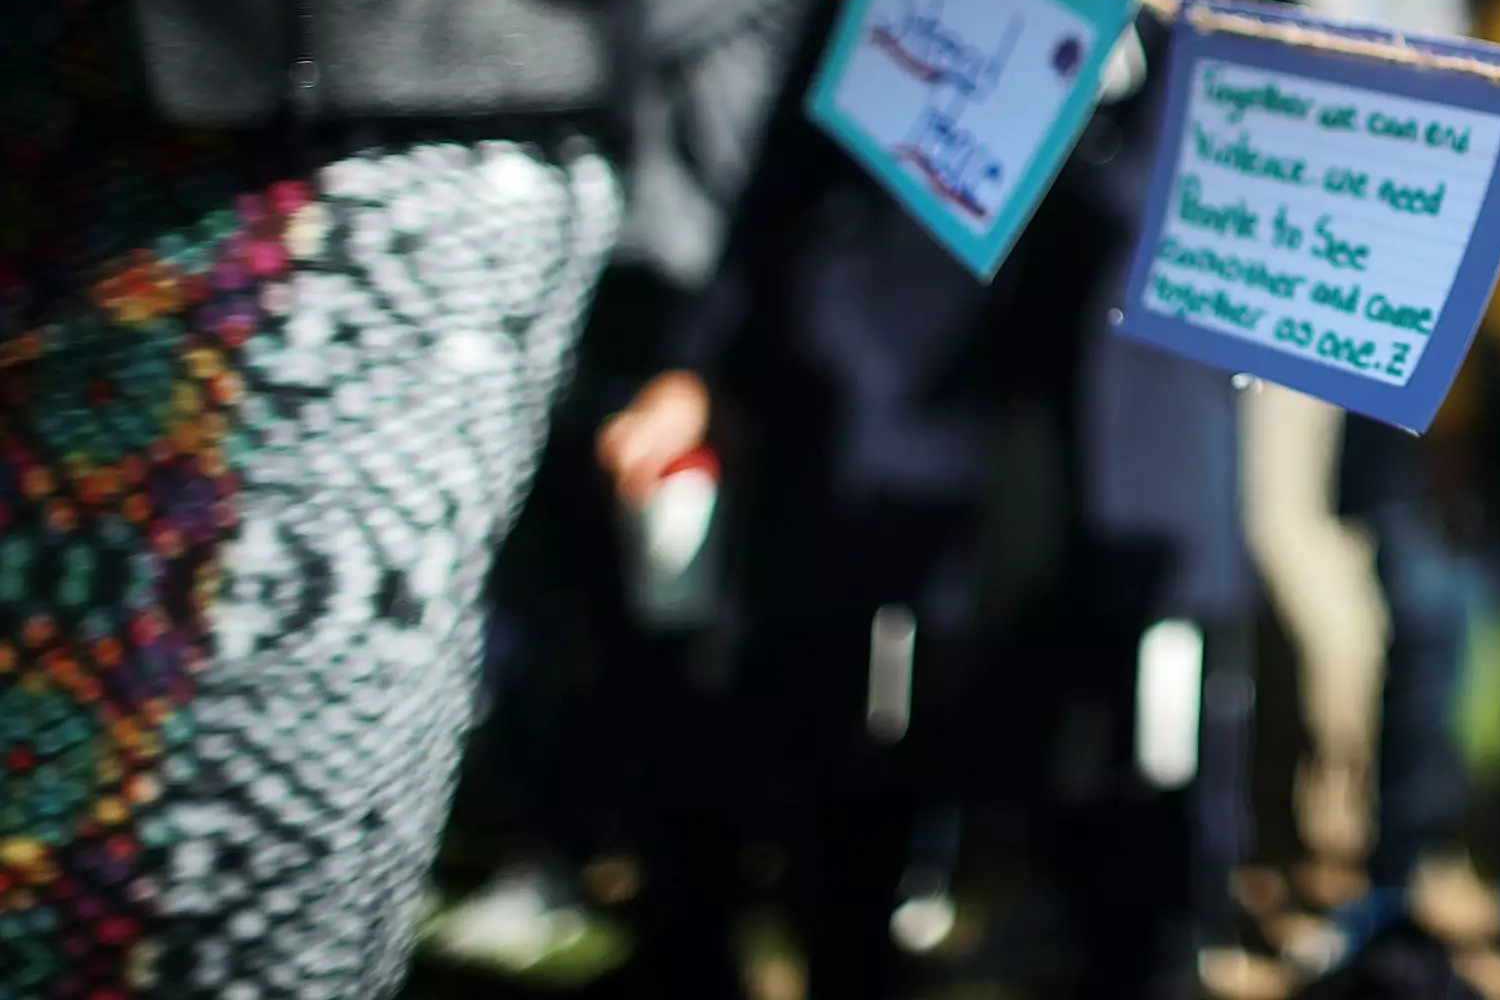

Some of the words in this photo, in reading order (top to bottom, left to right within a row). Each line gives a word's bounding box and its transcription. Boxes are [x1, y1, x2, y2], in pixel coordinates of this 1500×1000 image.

[1318, 106, 1358, 133] we
[1366, 111, 1419, 141] can
[1424, 120, 1472, 154] end
[1323, 166, 1369, 199] we
[1378, 178, 1447, 216] need
[1272, 204, 1304, 251] to
[1310, 282, 1361, 315] and
[1274, 316, 1314, 349] as
